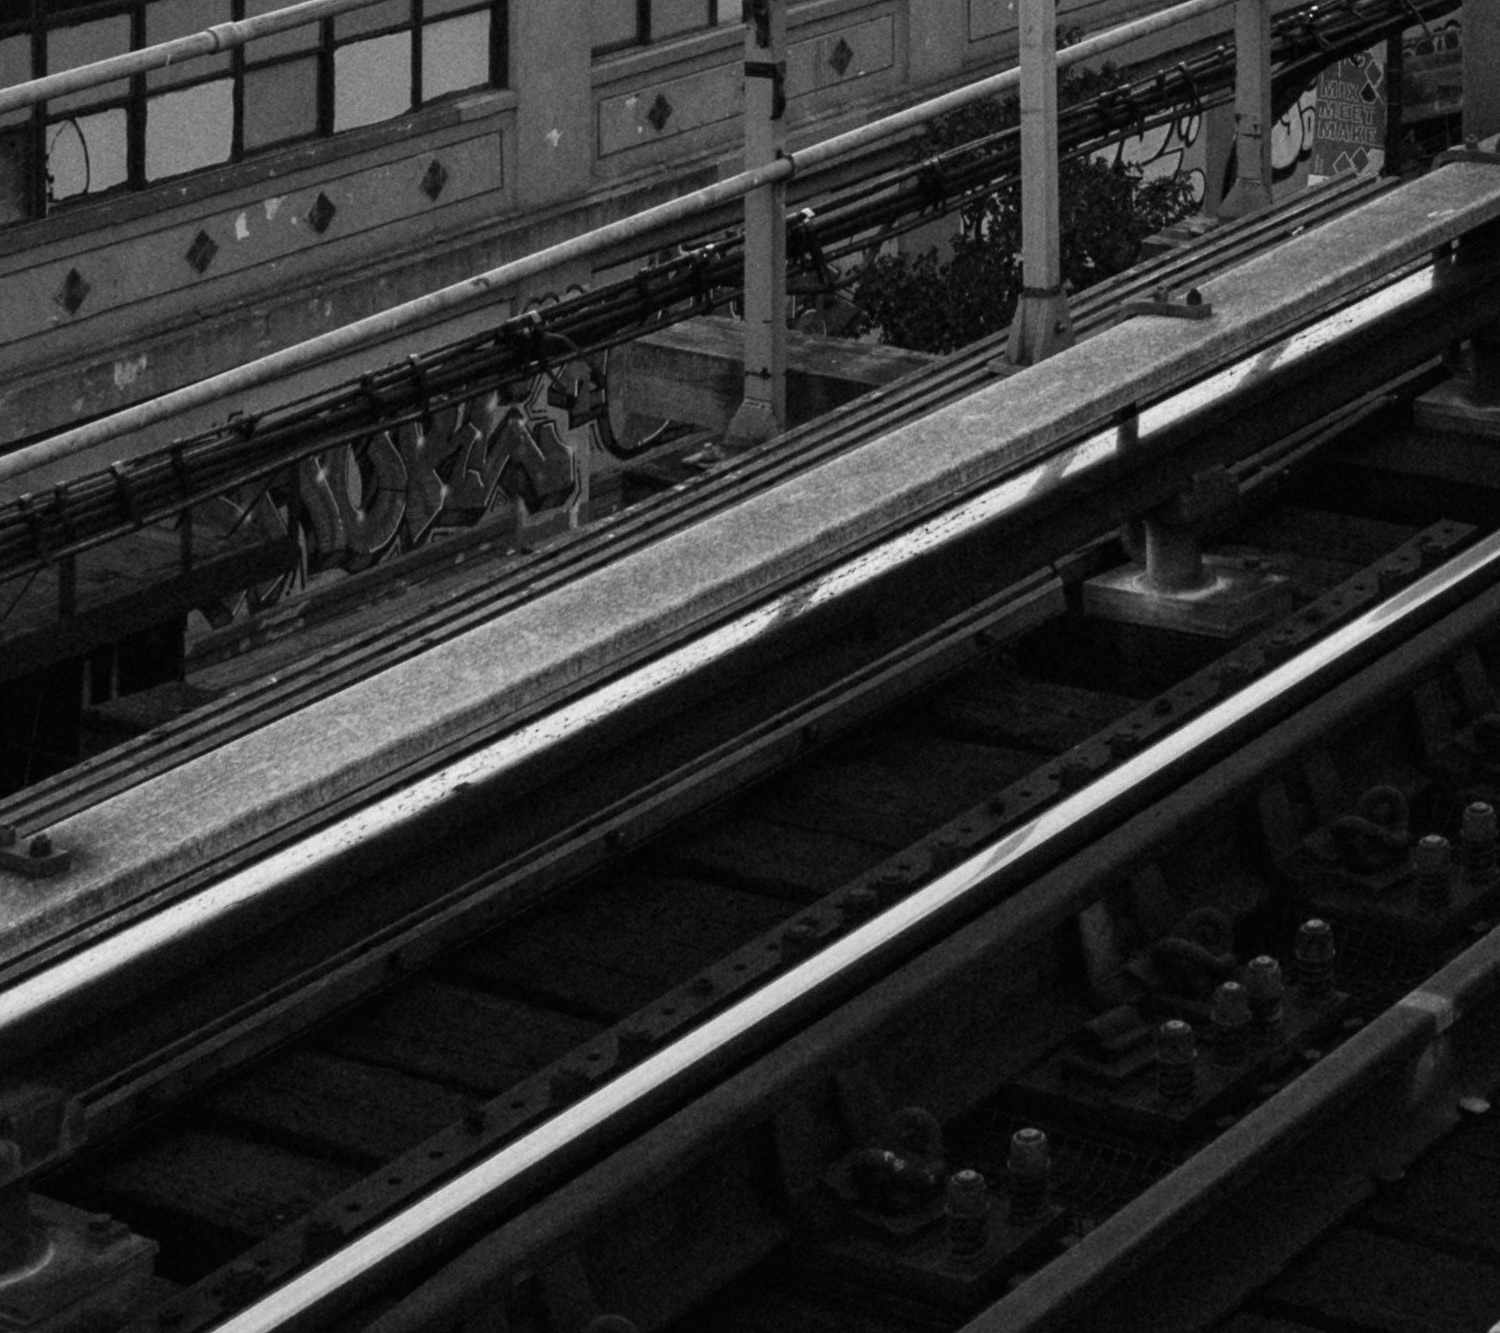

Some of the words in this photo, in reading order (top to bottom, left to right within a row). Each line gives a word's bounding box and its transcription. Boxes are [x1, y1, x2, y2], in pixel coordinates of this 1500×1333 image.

[1320, 79, 1360, 103] MIX
[1318, 98, 1375, 125] MEET
[1317, 120, 1378, 144] MAKE
